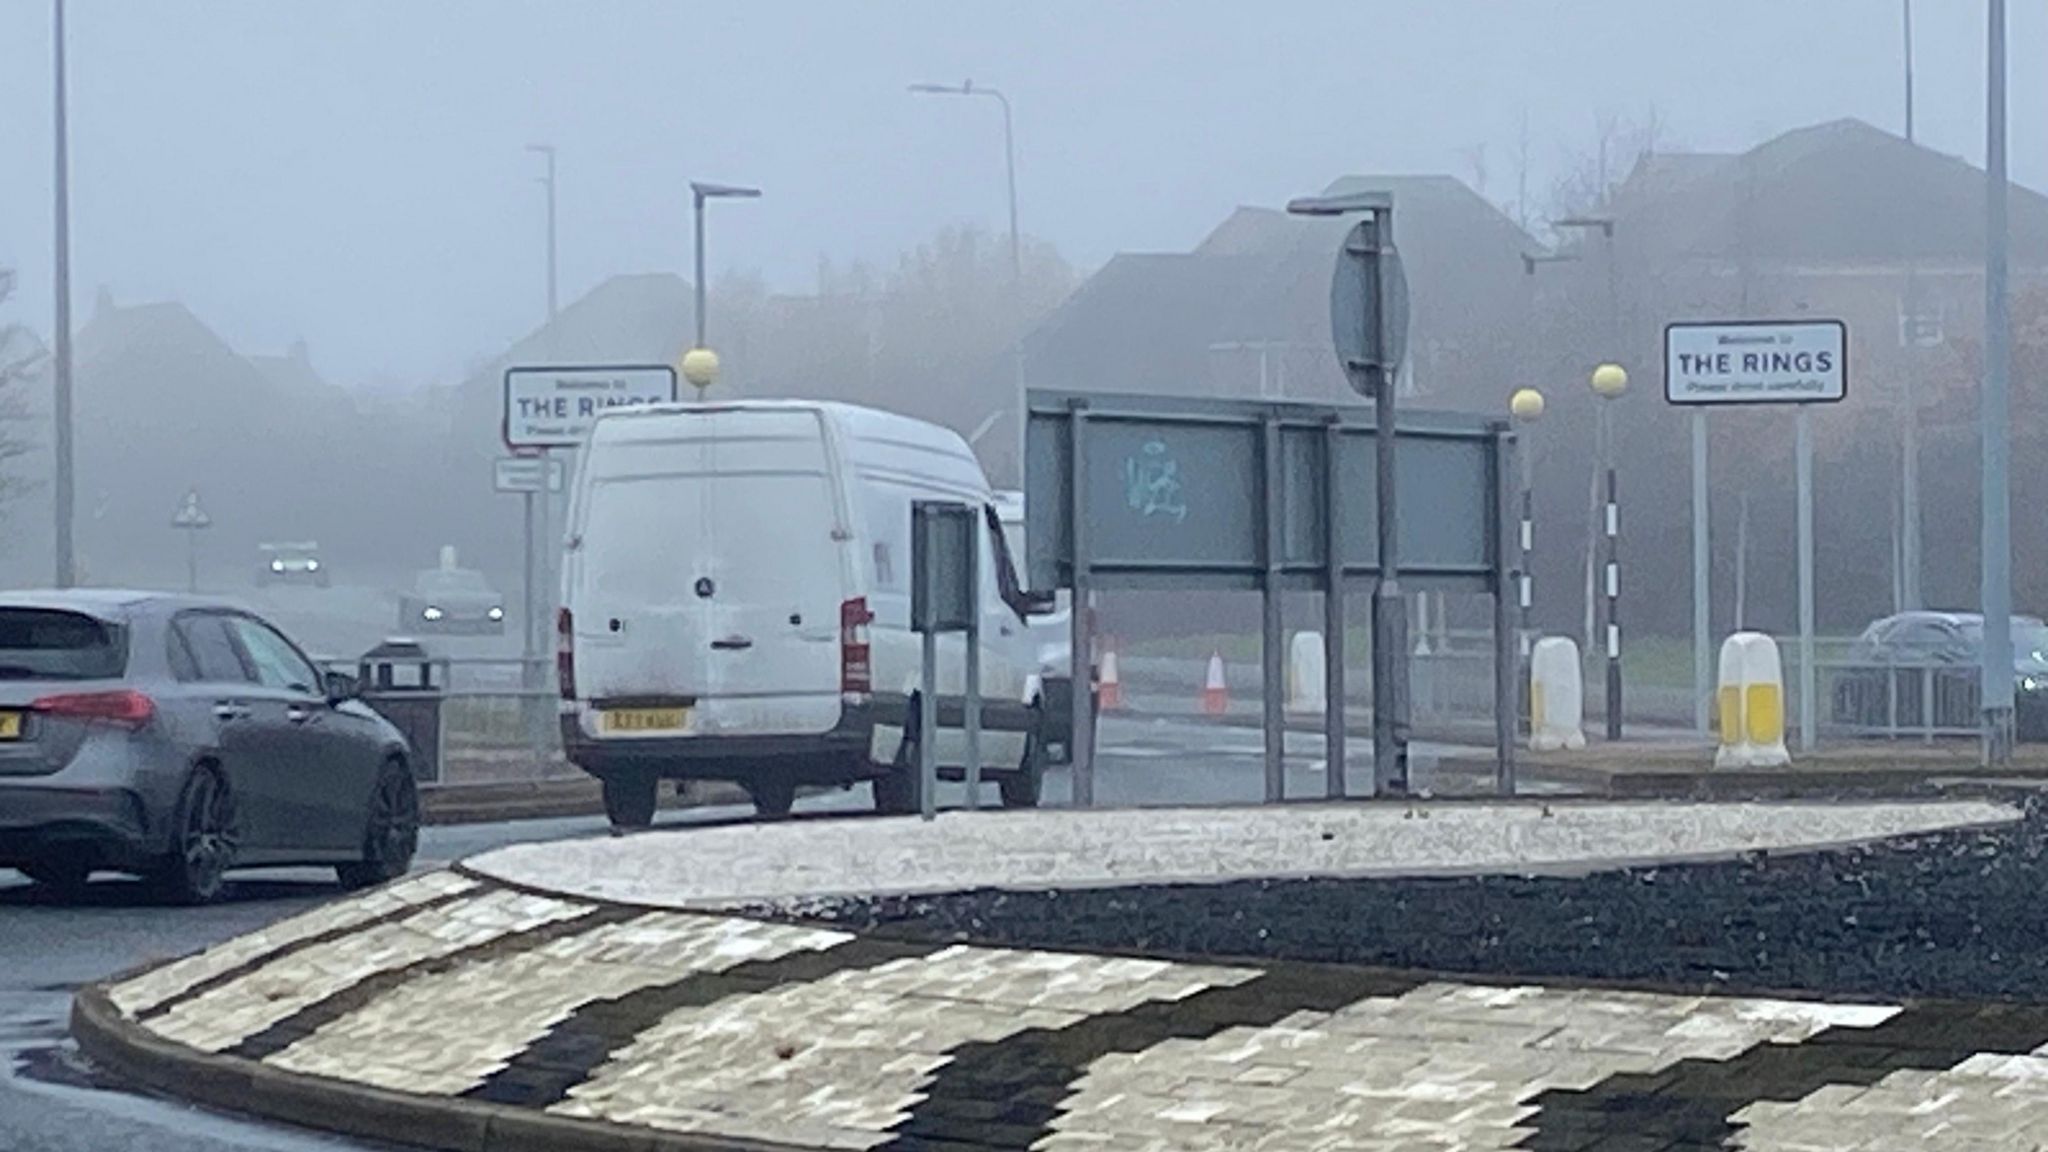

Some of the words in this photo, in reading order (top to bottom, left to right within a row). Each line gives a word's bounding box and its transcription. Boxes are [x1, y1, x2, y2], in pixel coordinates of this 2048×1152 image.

[1678, 353, 1732, 375] THE
[1742, 350, 1833, 374] RINGS
[516, 396, 568, 419] THE
